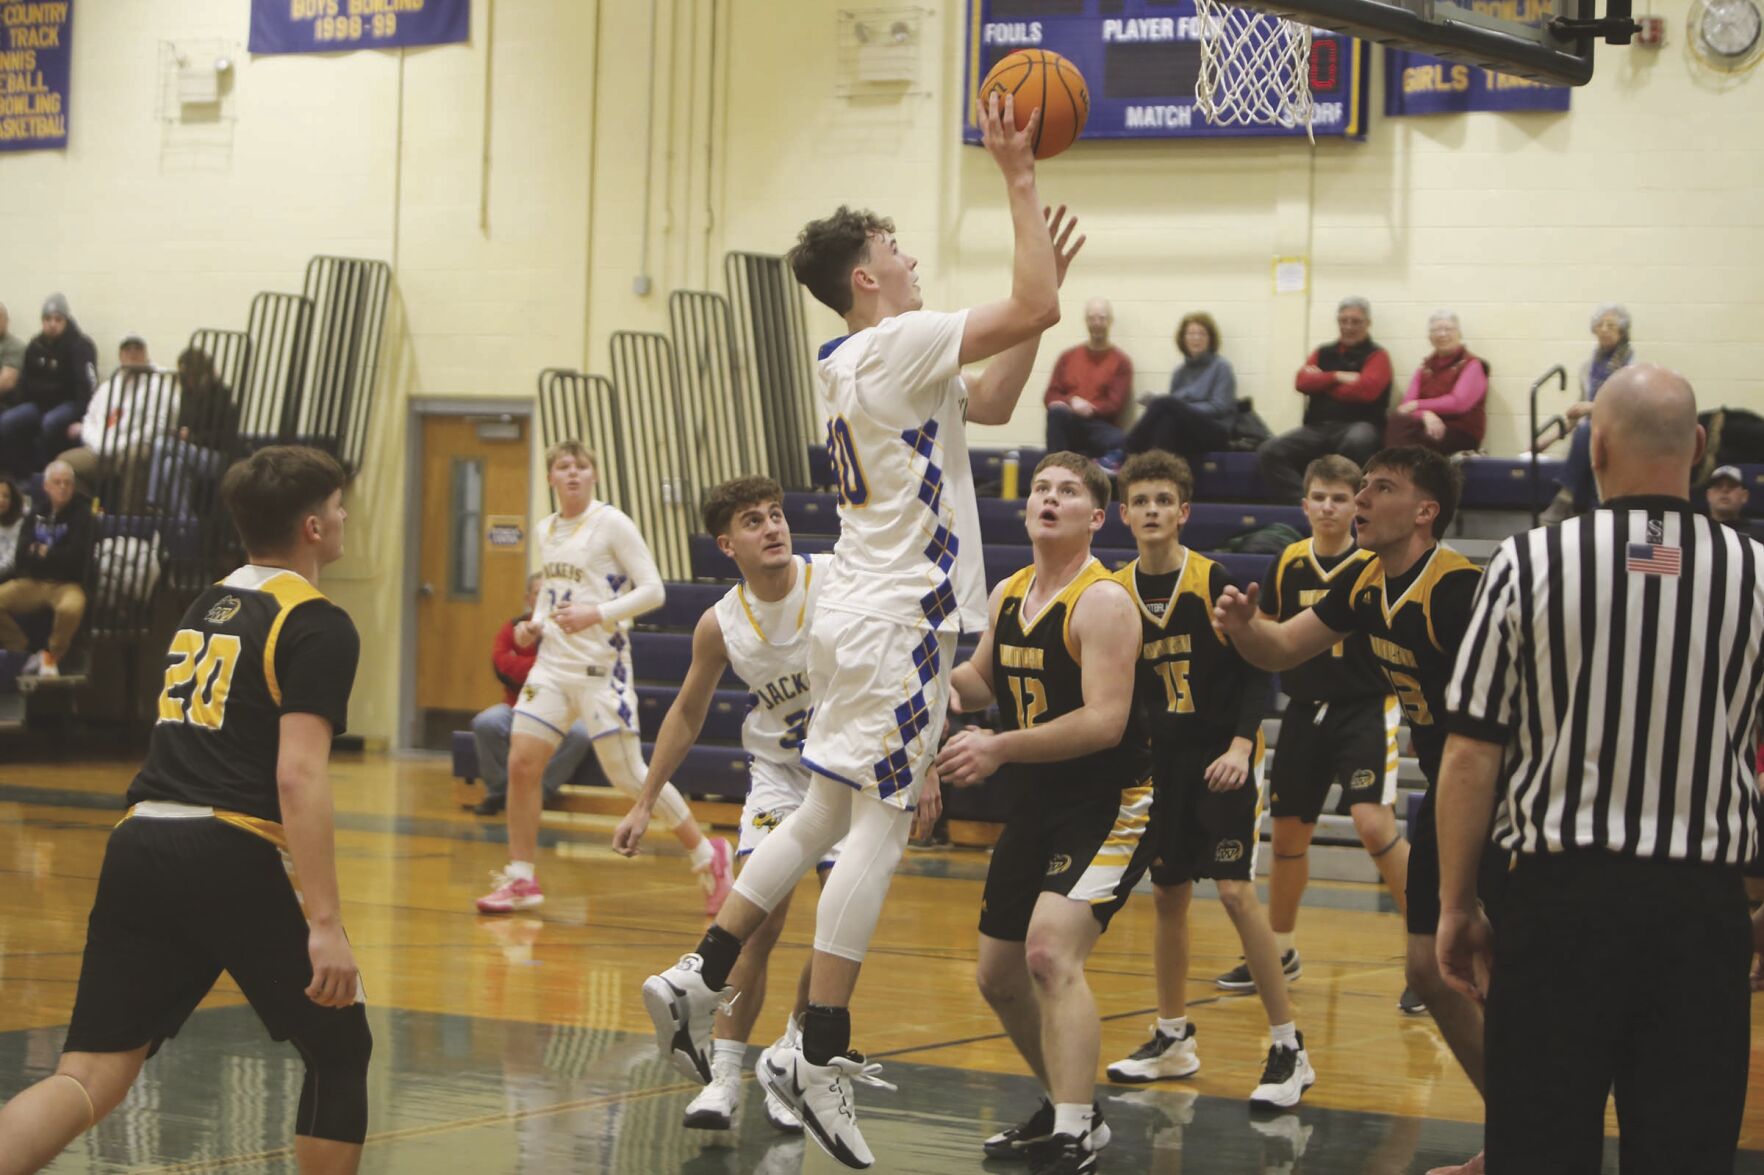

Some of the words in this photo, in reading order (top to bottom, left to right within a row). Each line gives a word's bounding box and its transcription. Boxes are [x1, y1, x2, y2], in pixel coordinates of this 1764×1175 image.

[4, 3, 67, 25] COUNTRY
[314, 12, 397, 41] 1998-99
[10, 27, 59, 48] TRACK
[984, 22, 1042, 43] FOULS
[1102, 18, 1174, 41] PLAYER
[1311, 39, 1337, 90] 0
[1402, 64, 1469, 94] GIRLS
[1125, 105, 1192, 128] MATCH
[156, 629, 242, 730] 20
[1153, 660, 1196, 713] 15
[1007, 675, 1048, 730] 12
